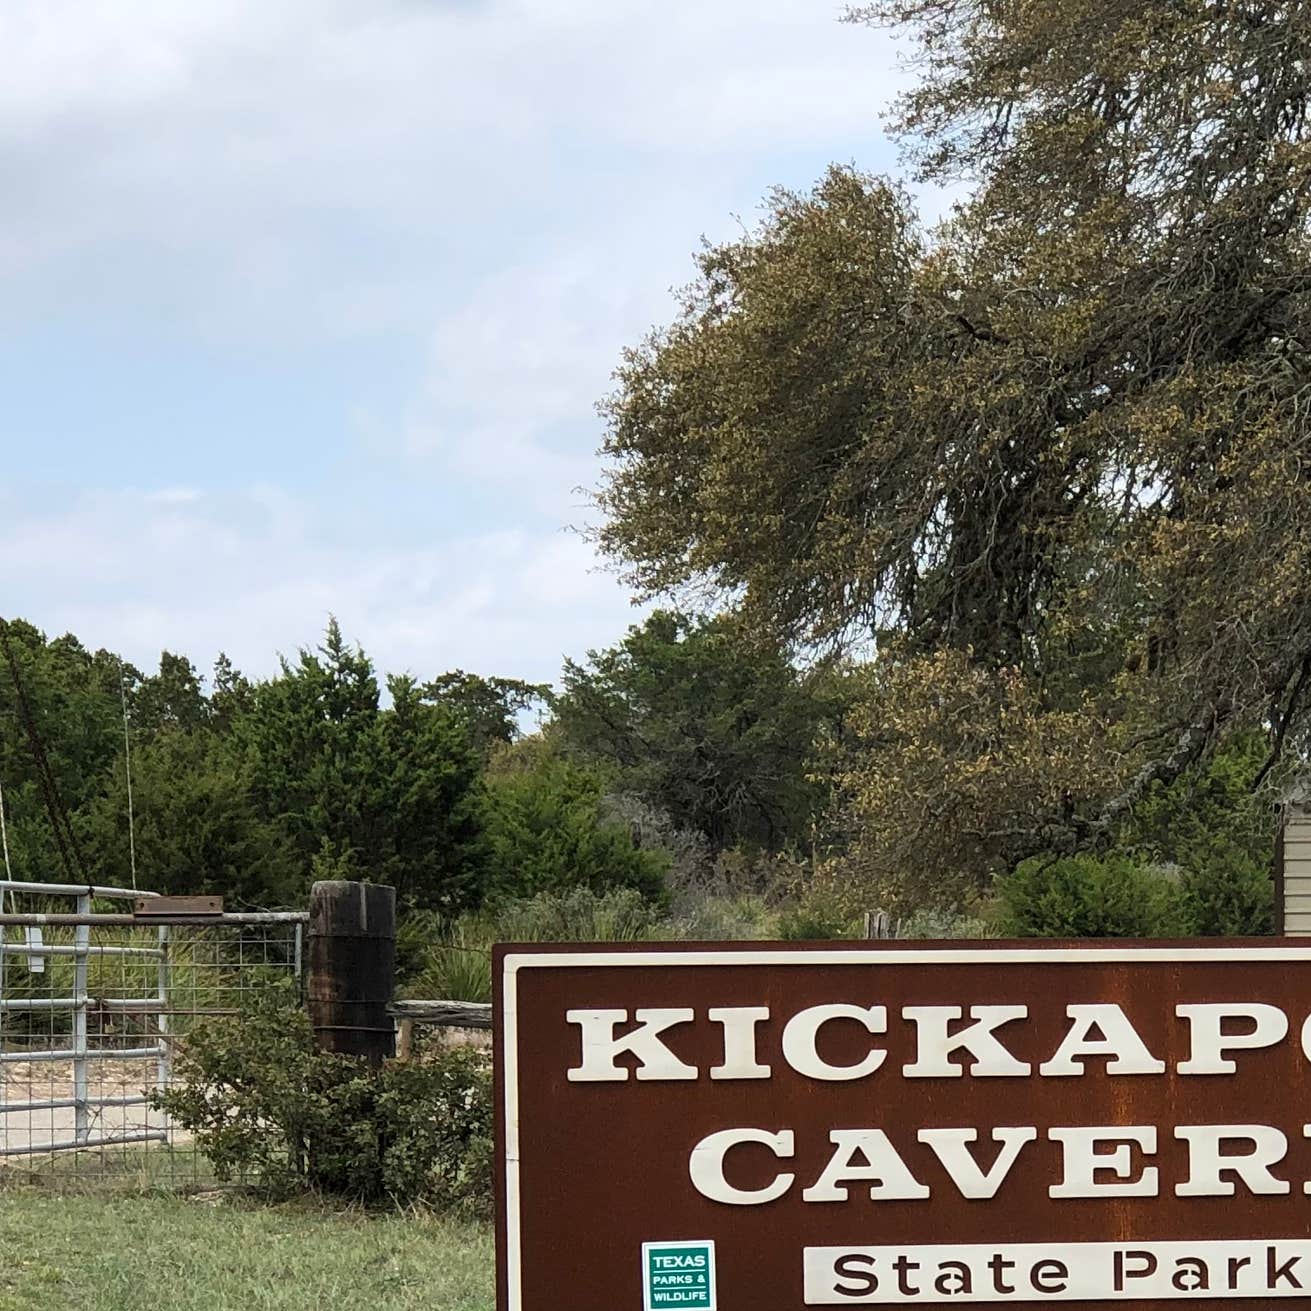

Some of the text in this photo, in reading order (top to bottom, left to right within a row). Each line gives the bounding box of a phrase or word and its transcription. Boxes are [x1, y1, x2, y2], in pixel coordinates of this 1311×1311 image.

[652, 1255, 706, 1268] TEXAS
[833, 1246, 1303, 1297] State Park
[653, 1274, 706, 1285] PARKS &
[653, 1291, 707, 1302] WILDLIFE
